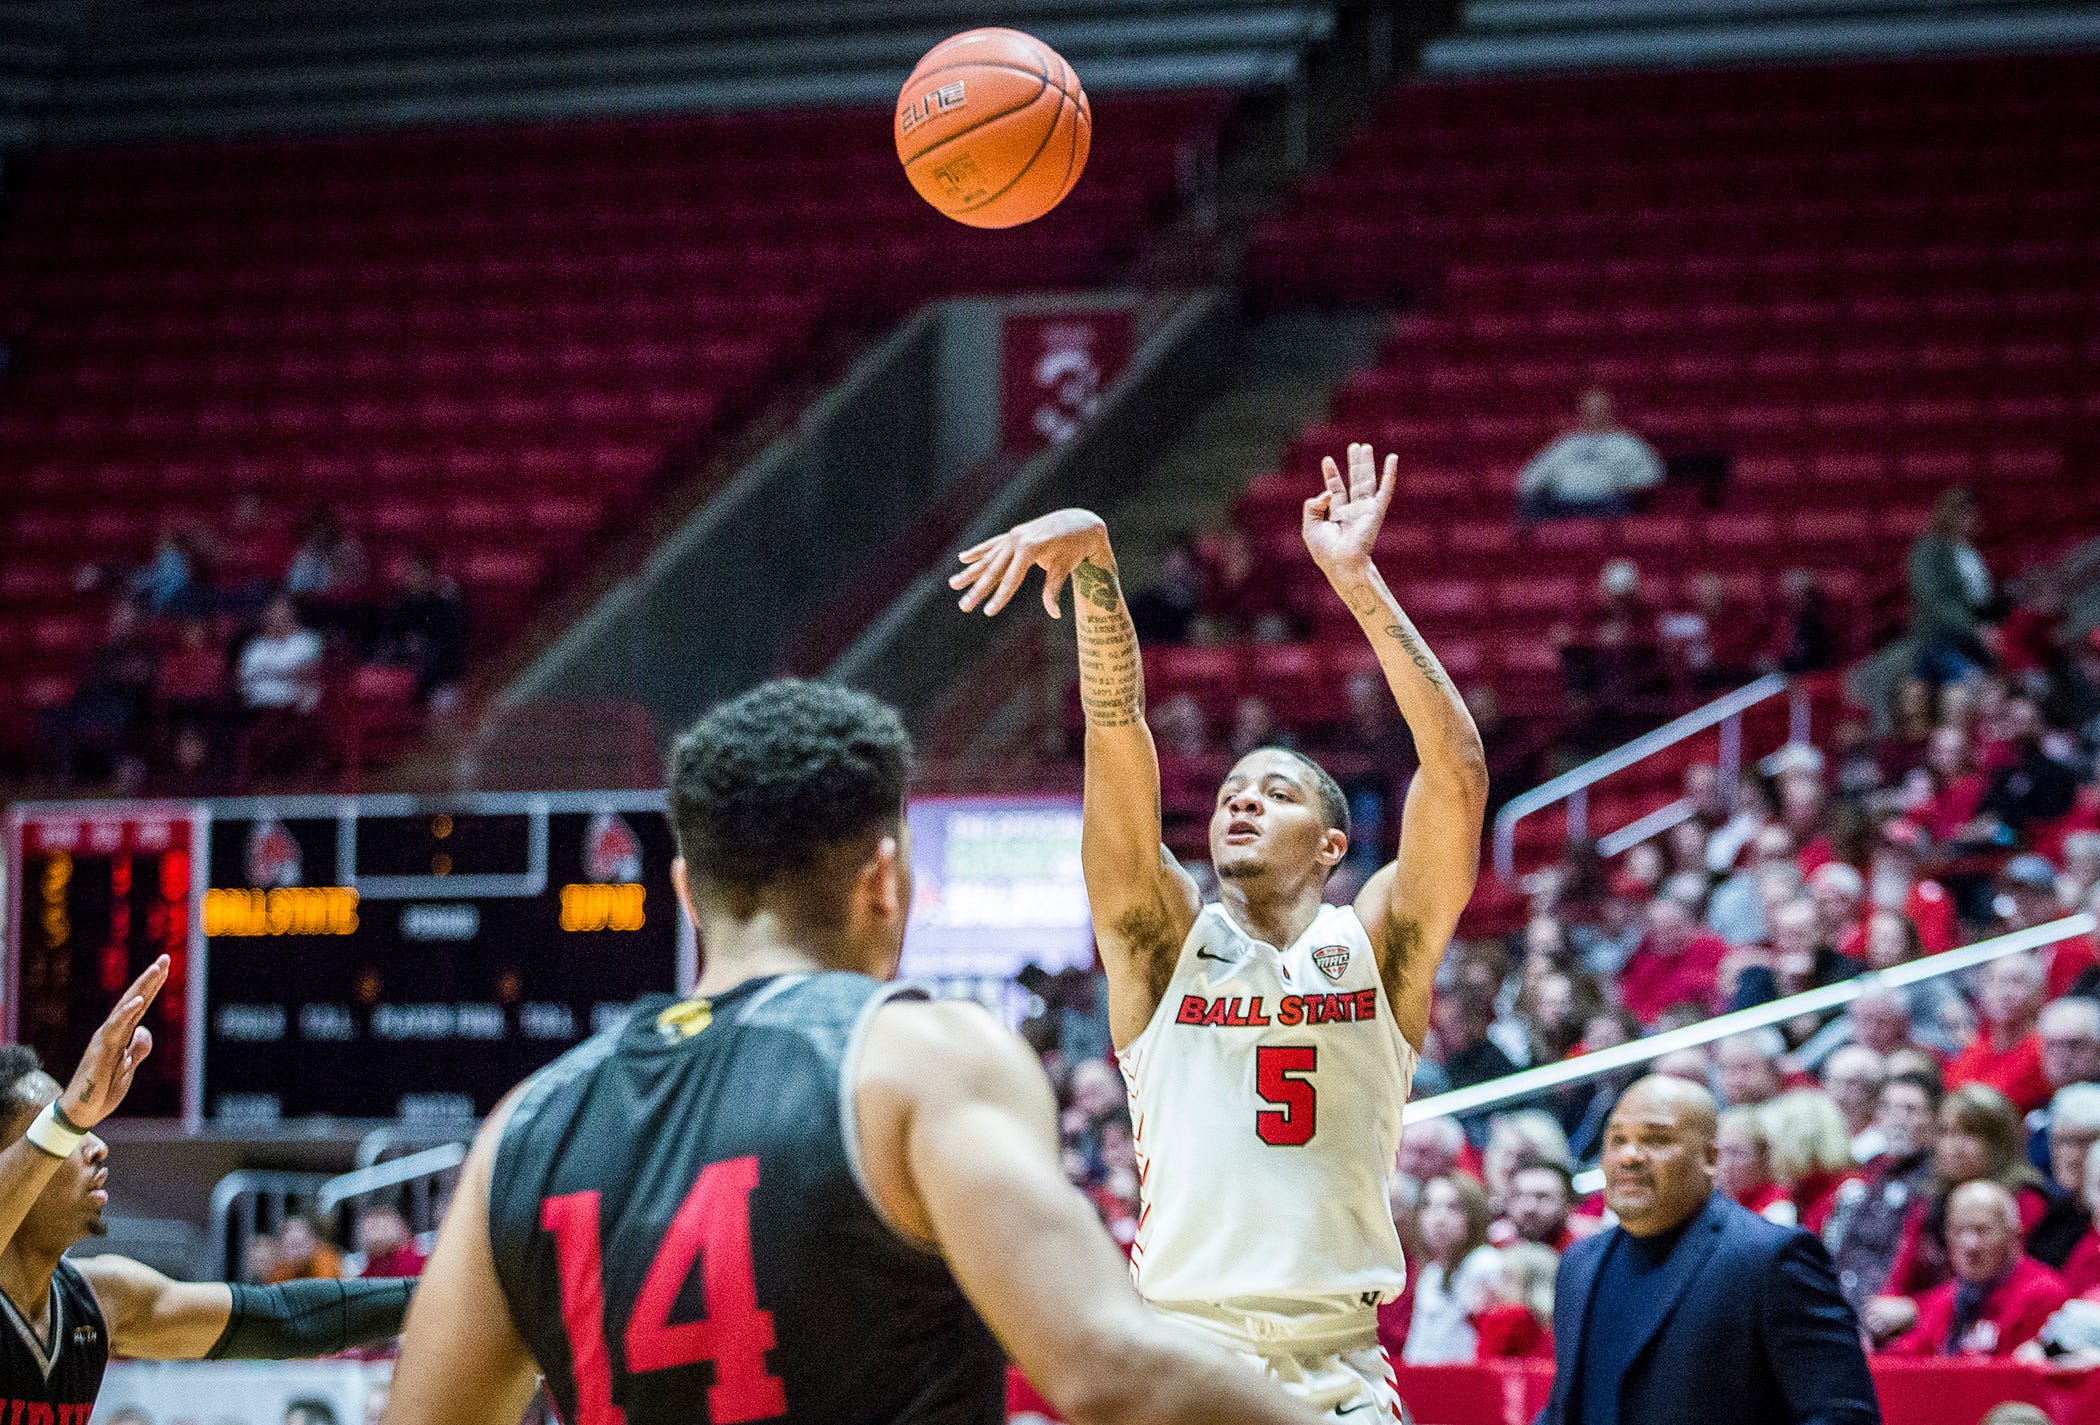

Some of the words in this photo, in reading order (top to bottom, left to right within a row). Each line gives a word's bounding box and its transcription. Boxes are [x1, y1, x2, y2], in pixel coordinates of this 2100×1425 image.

[901, 80, 967, 132] ELITE
[1316, 953, 1350, 968] MAC
[1175, 994, 1271, 1027] BALL
[1277, 988, 1377, 1026] STATE
[1256, 1046, 1318, 1147] 5
[540, 1156, 789, 1425] 14
